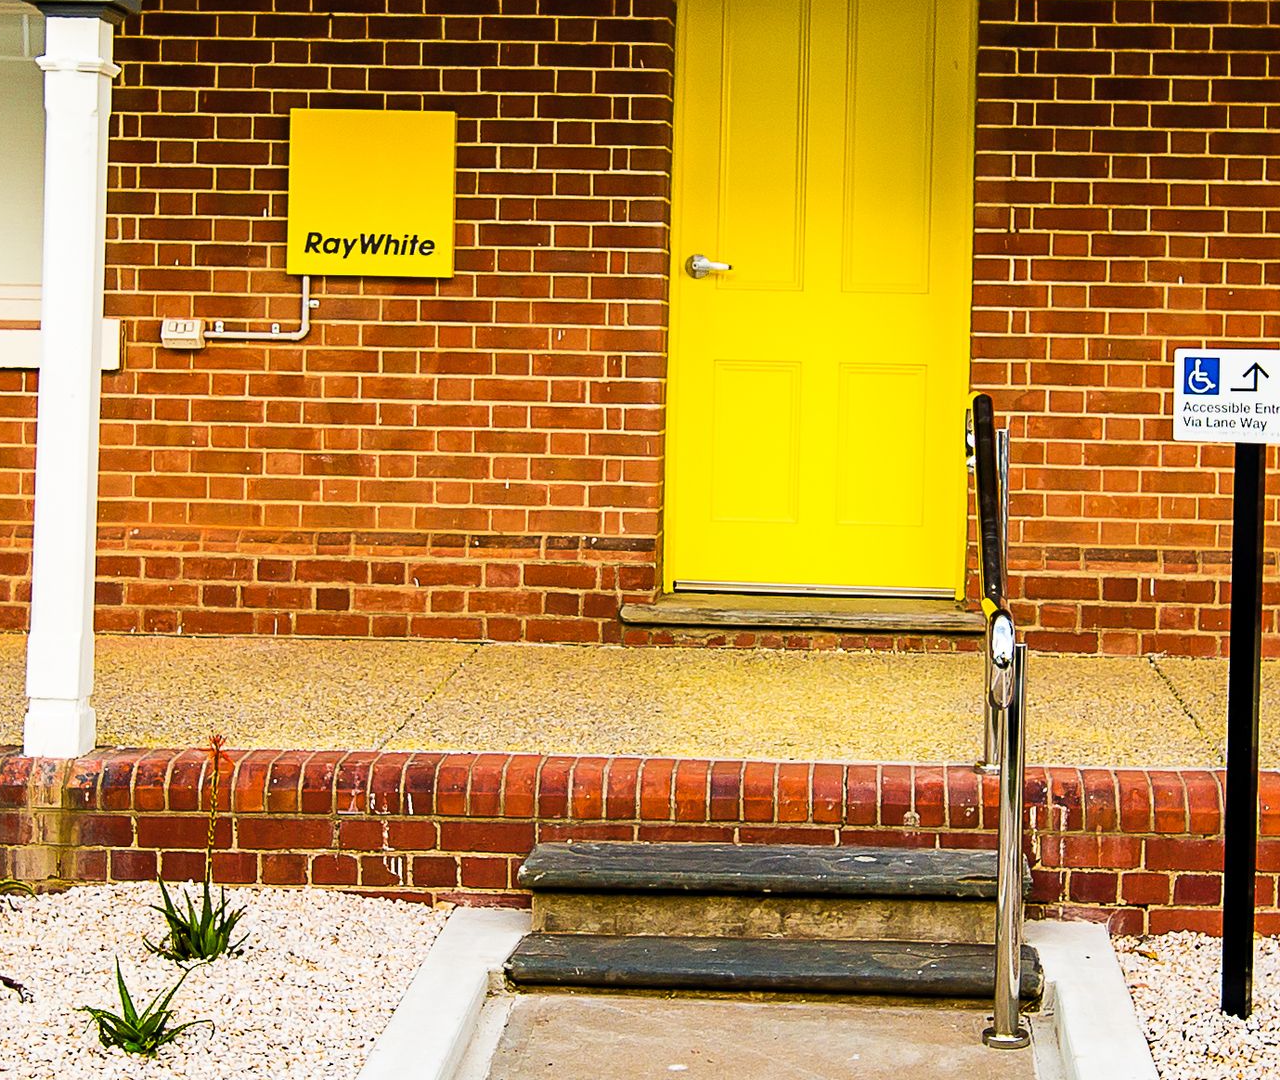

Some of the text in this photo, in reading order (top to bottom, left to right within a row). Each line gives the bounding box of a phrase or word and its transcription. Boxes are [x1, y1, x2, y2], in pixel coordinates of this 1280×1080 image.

[304, 232, 435, 259] RayWhite
[1183, 401, 1251, 414] Accessible
[1183, 417, 1268, 432] Via Lane Way
